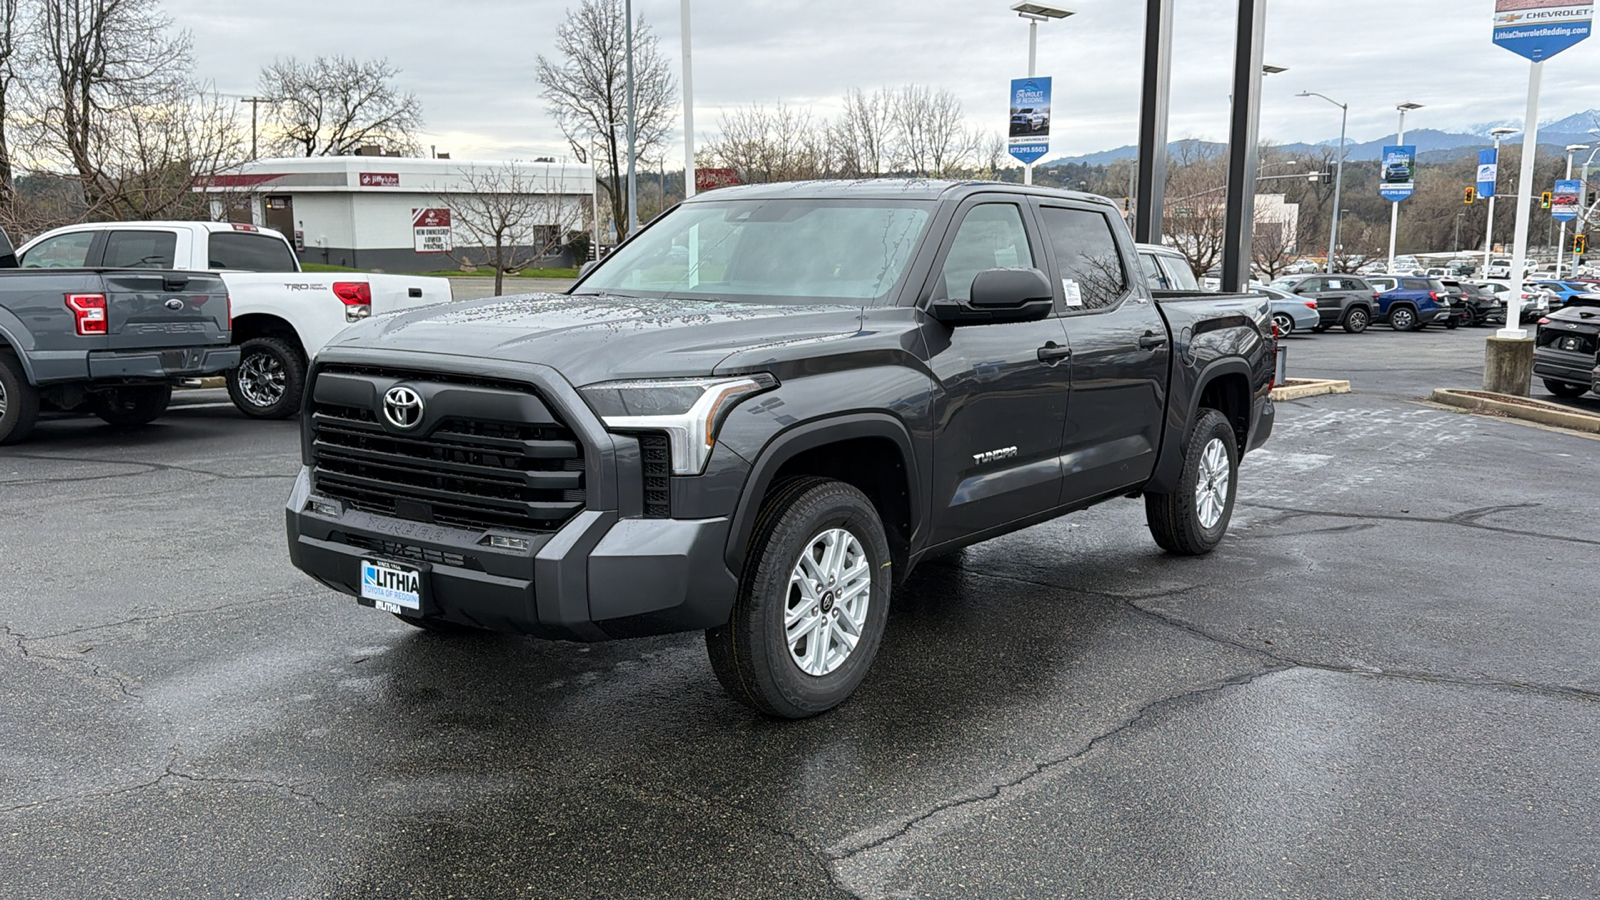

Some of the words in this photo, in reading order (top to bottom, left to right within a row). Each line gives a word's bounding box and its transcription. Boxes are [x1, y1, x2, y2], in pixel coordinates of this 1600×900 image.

[1526, 9, 1590, 19] CHEVROLET
[1495, 27, 1588, 40] LithiaChevroletRedding.com
[1010, 146, 1047, 154] 877.293.5503
[972, 446, 1018, 465] TUNDRA
[376, 568, 420, 594] LITHIA
[363, 584, 385, 597] TOYOTA
[385, 589, 393, 598] OF
[394, 591, 419, 603] REDDIN
